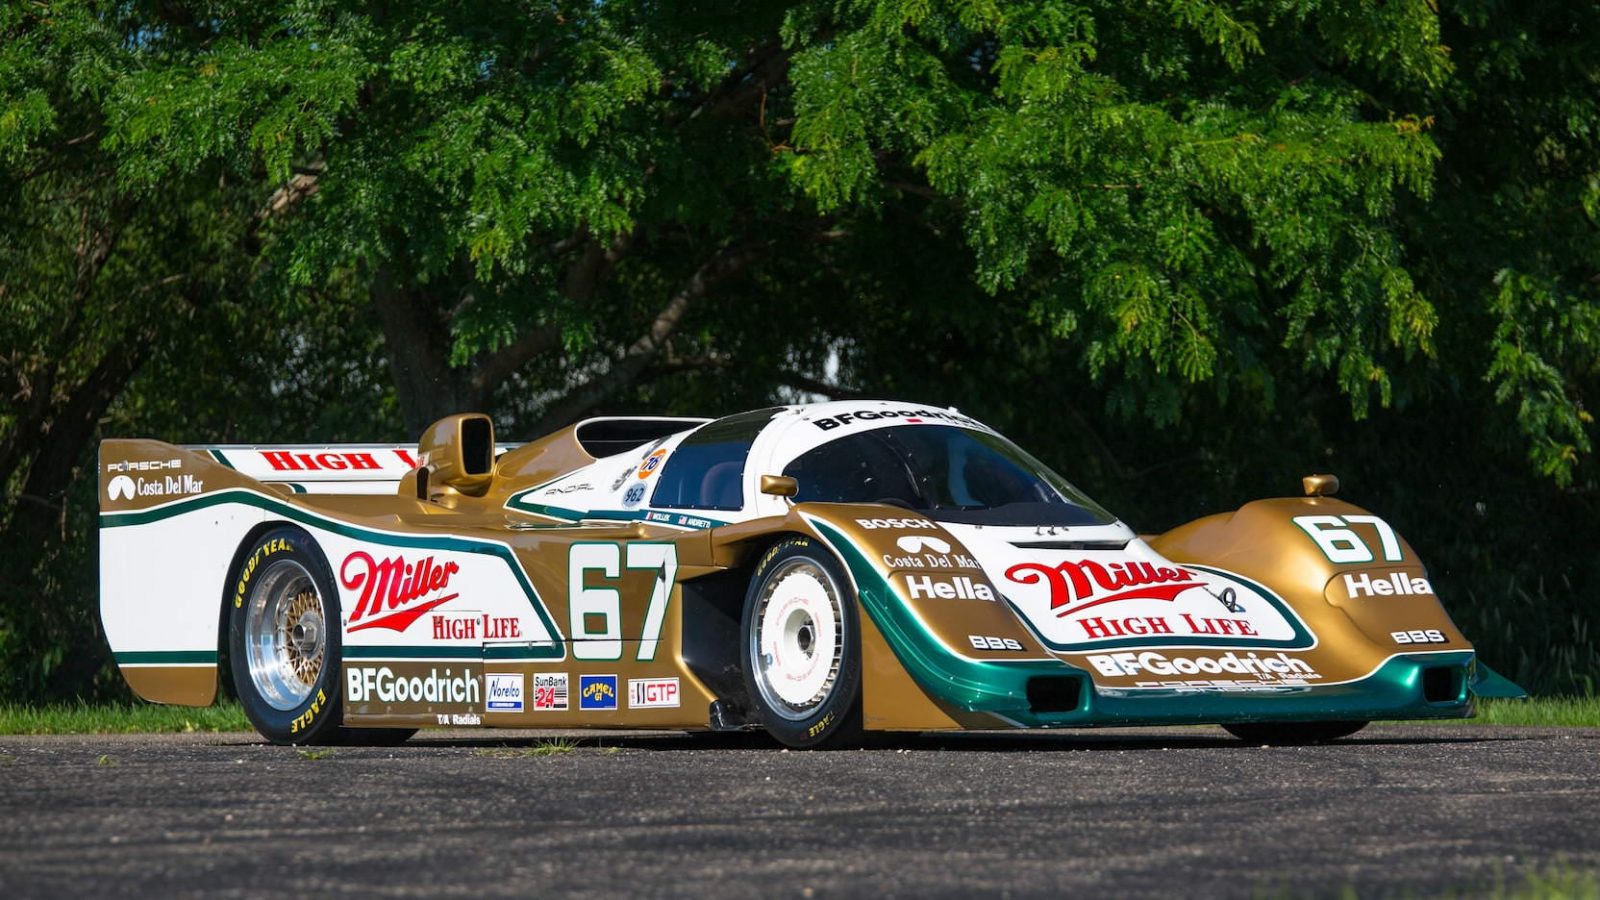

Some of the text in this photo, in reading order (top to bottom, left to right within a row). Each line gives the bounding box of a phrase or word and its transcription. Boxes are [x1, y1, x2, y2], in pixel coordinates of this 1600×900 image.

[107, 459, 182, 473] PORSCHE
[258, 451, 384, 470] HIGH
[137, 474, 204, 496] Costa Del Mar
[625, 488, 645, 502] 962
[855, 518, 938, 530] BOSCH
[1292, 515, 1403, 563] 67
[883, 554, 983, 570] Costa Del Mar
[340, 550, 460, 623] Miller
[905, 575, 996, 602] Hella
[1004, 558, 1200, 610] Miller
[1344, 572, 1434, 599] Hella
[569, 541, 678, 662] 67
[432, 614, 521, 640] HIGH LIFE
[1076, 613, 1260, 639] HIGH LIFE
[1391, 630, 1446, 644] BBS
[968, 635, 1023, 650] BBS
[1086, 651, 1315, 677] BFGoodrich
[346, 666, 480, 703] BFGoodrich
[489, 677, 520, 701] Norelco
[535, 676, 567, 687] SunBank
[583, 683, 614, 698] CAMEL
[647, 683, 677, 702] GTP
[535, 687, 555, 707] 24
[291, 688, 328, 734] EAGLE
[453, 713, 481, 725] Radials
